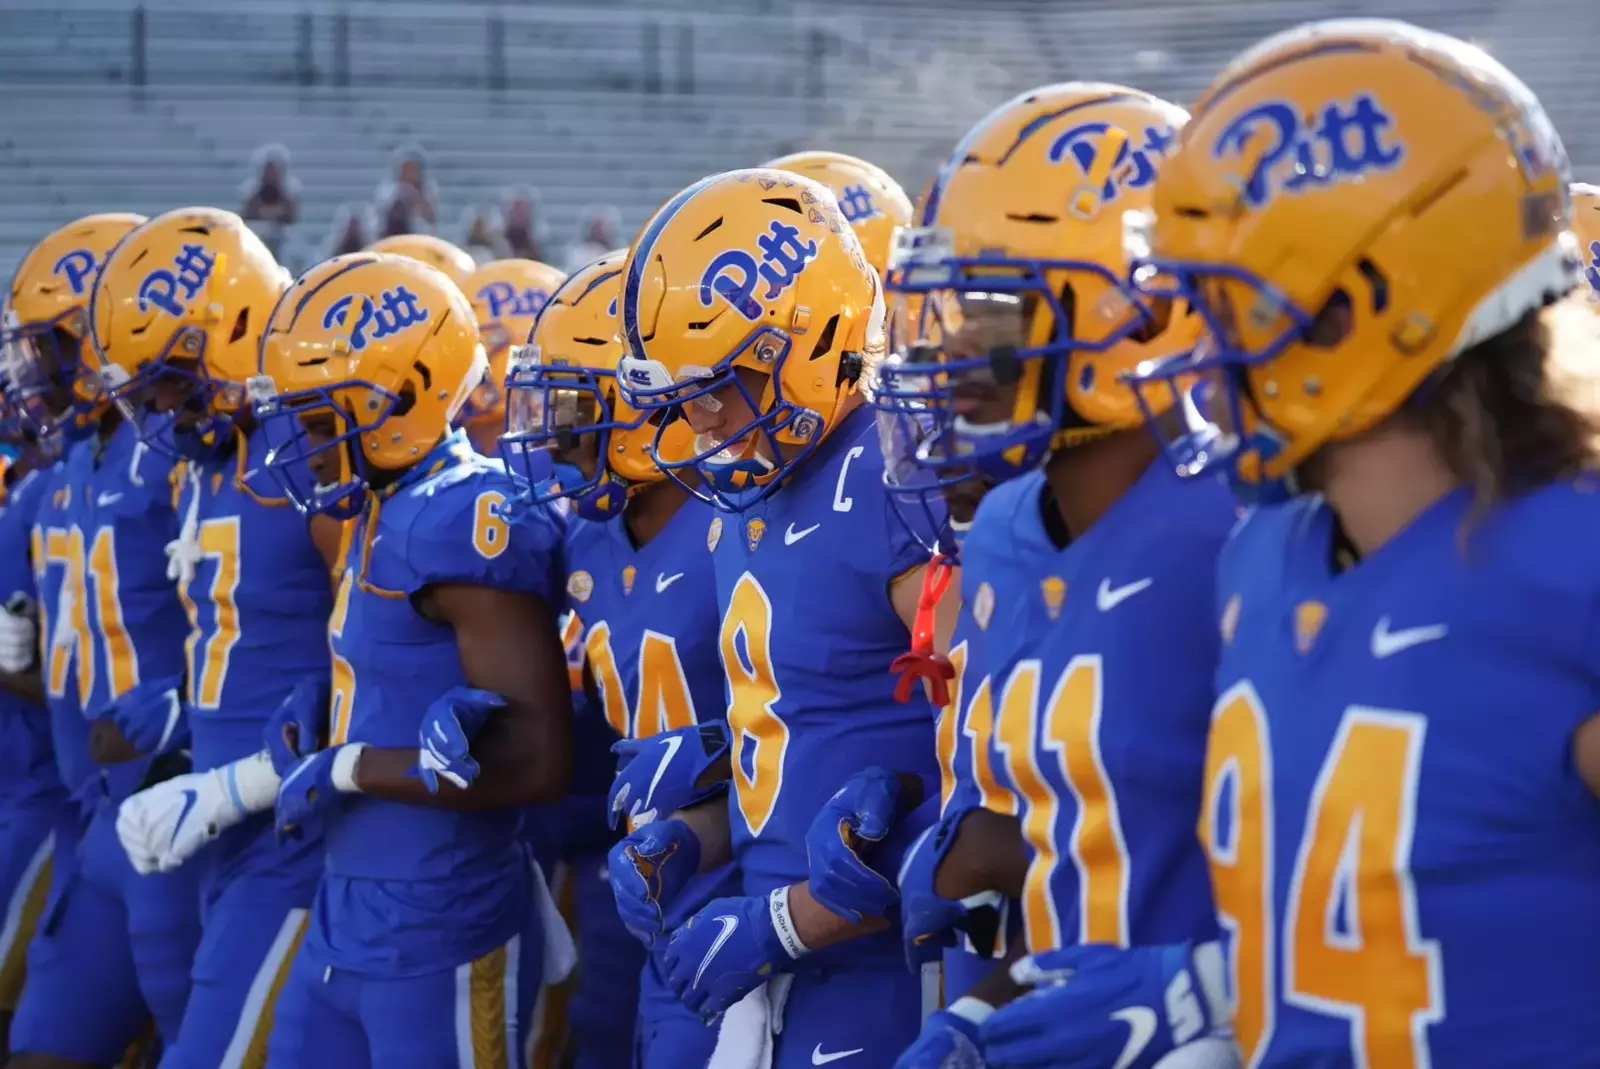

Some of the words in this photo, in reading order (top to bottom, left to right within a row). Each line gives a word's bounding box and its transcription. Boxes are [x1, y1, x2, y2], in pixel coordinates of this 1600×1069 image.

[1211, 92, 1405, 207] Pitt
[138, 243, 216, 317] Pitt
[322, 284, 429, 351] Pitt
[698, 219, 818, 322] Pitt
[471, 490, 512, 560] 6
[832, 445, 865, 513] C
[718, 570, 790, 839] 8
[993, 653, 1131, 951] 11
[1196, 678, 1447, 1069] 94
